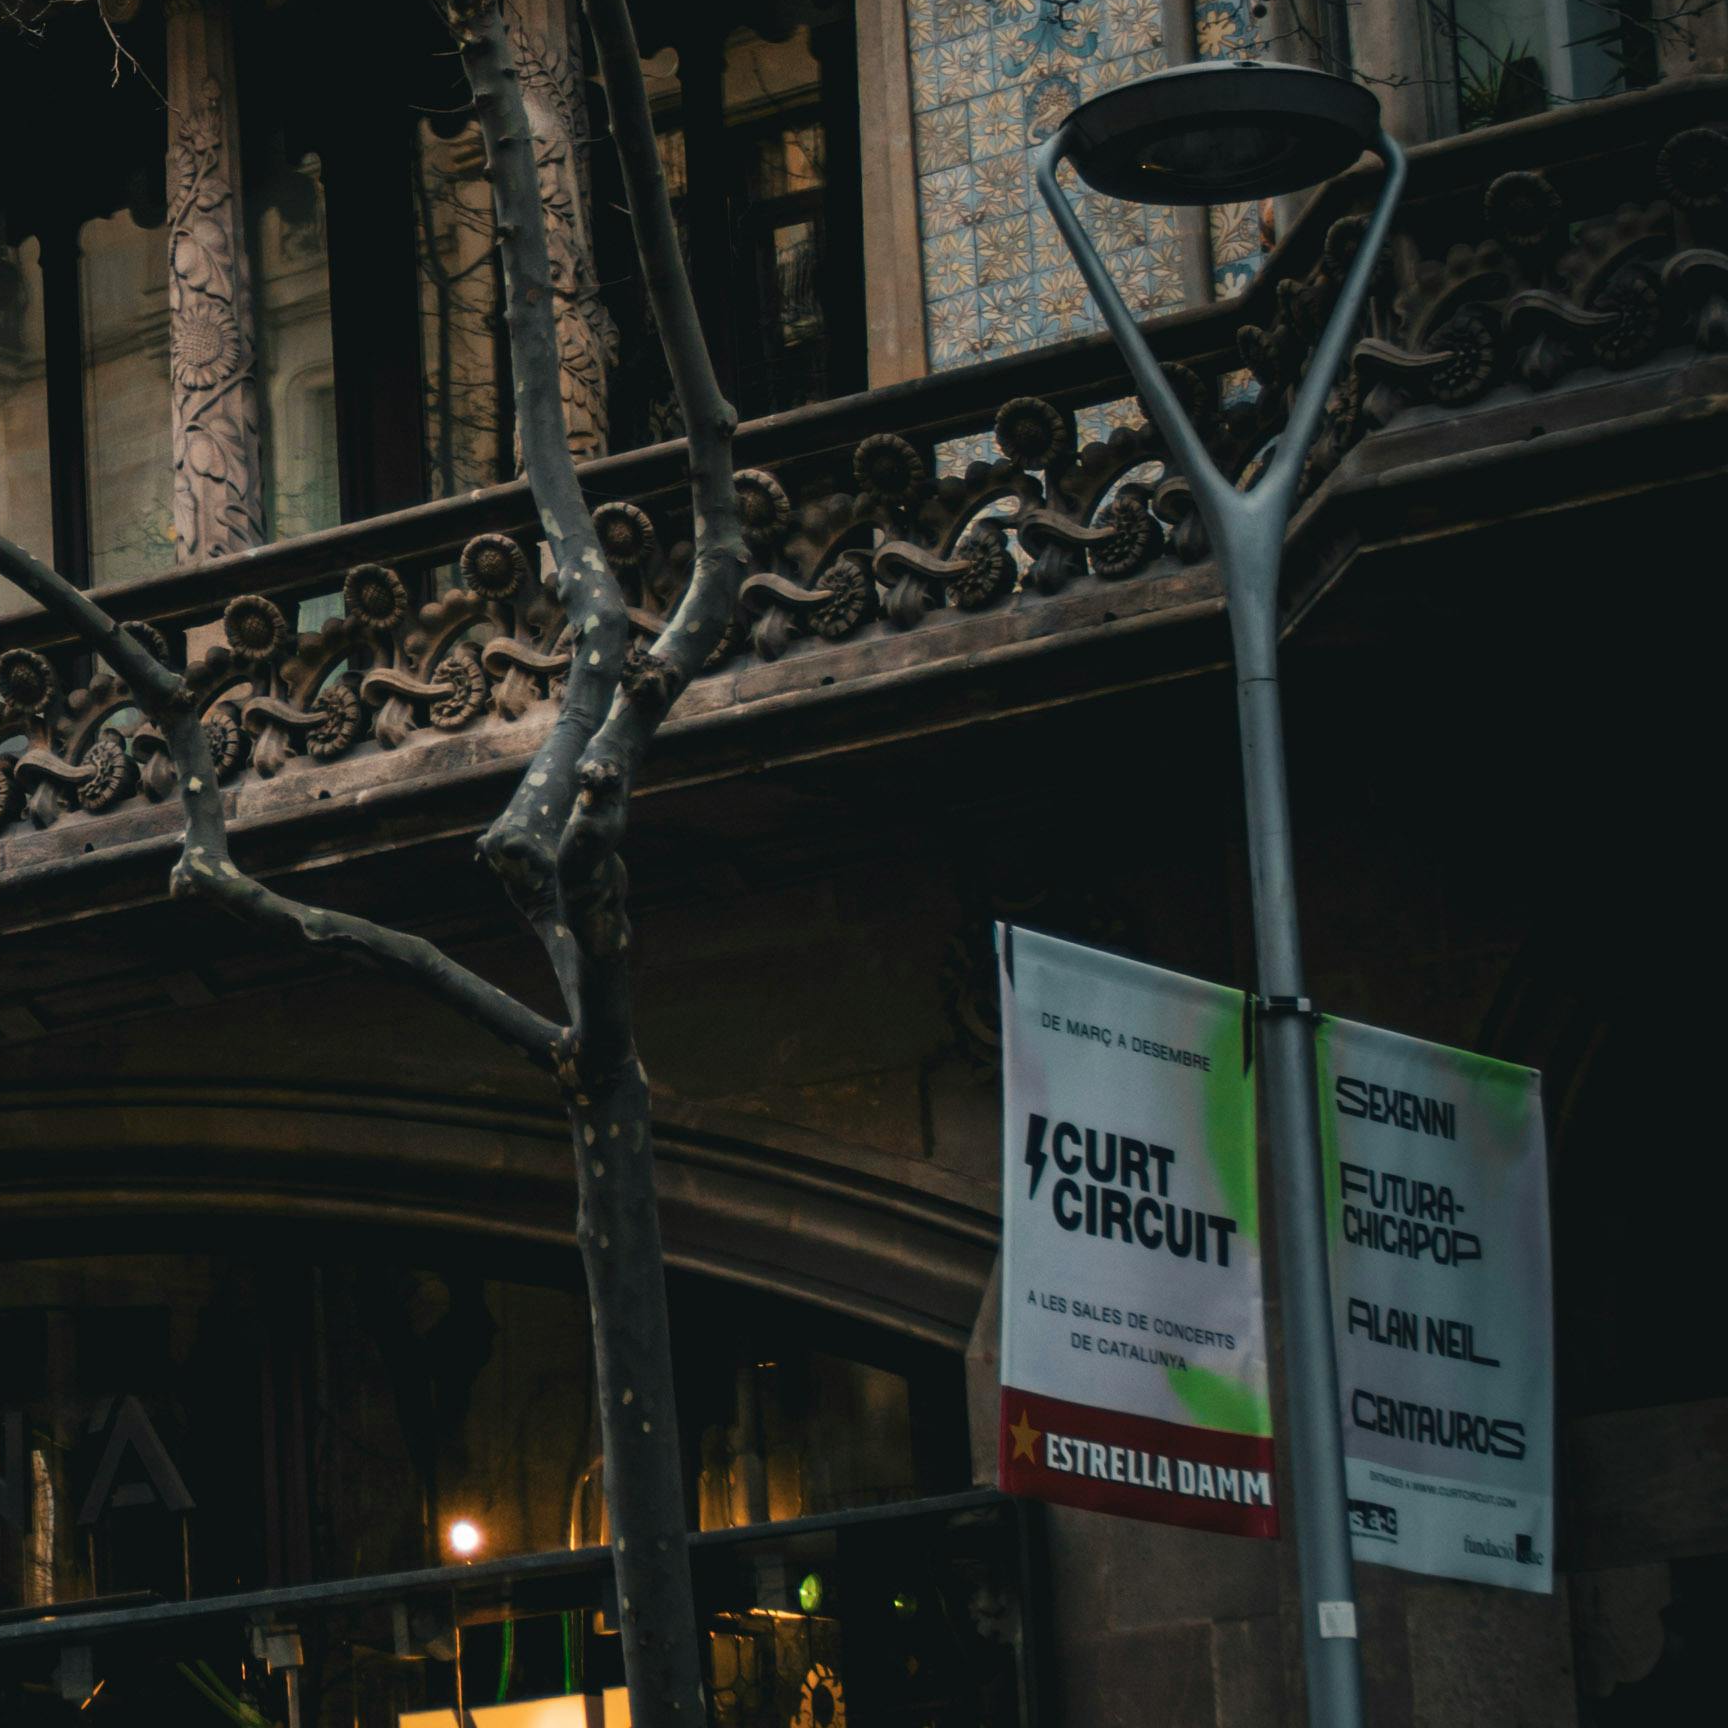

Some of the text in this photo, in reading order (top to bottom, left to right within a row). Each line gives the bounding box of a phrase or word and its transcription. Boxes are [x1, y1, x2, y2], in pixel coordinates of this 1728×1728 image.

[1041, 1012, 1212, 1072] DE MARÇ A DESEMBRE
[1335, 1075, 1456, 1141] SEXENNI
[1052, 1121, 1175, 1198] CURT
[1052, 1177, 1237, 1268] CIRCUIT
[1343, 1203, 1482, 1268] CHICAPOP
[1027, 1290, 1235, 1350] A LES SALES DE CONCERTS
[1071, 1332, 1188, 1372] DE CATALUNYA
[1348, 1297, 1500, 1368] ALAN NEIL
[1351, 1388, 1526, 1461] CENTAUROS
[1045, 1432, 1273, 1507] ESTRELLA DAMM
